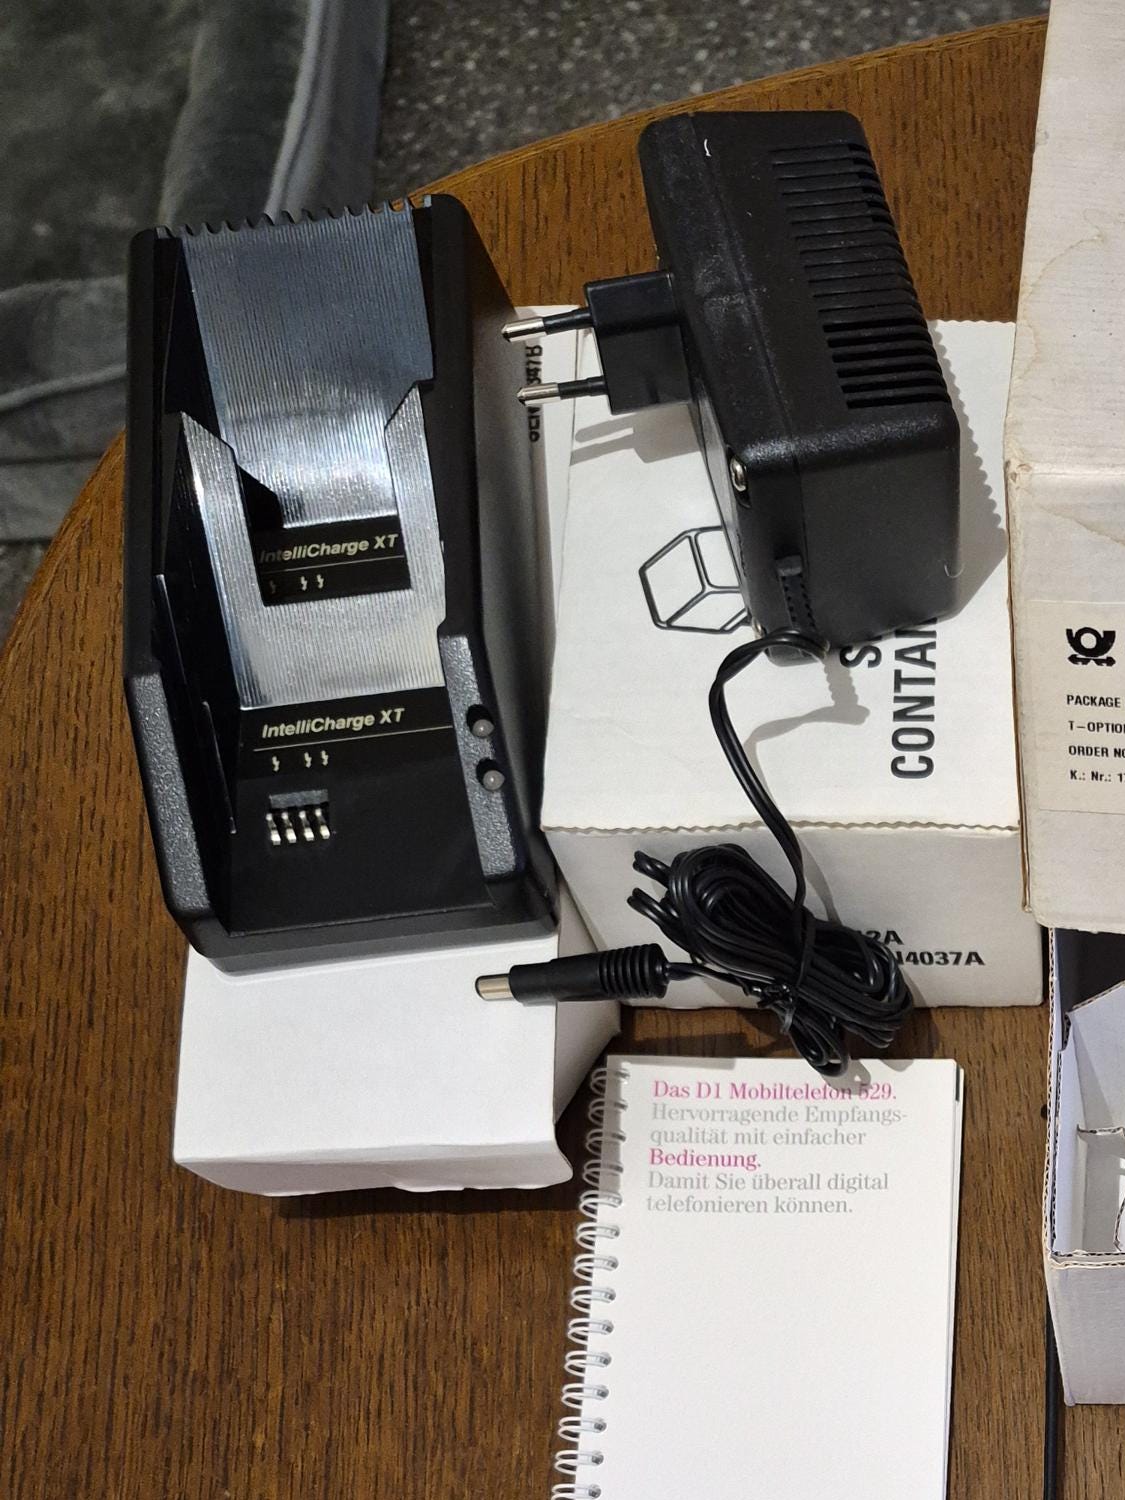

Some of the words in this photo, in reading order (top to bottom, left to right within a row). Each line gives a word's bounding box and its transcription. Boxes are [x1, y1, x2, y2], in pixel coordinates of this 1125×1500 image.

[259, 539, 369, 563] IntelliCharge
[374, 533, 398, 549] XT
[1067, 695, 1120, 708] PACKAGE
[262, 714, 375, 738] IntelliCharge
[380, 708, 405, 724] XT
[1069, 746, 1109, 757] ORDER
[652, 1080, 690, 1098] Das
[696, 1082, 721, 1099] D1
[730, 1082, 850, 1100] Mobiltelefon
[652, 1103, 799, 1124] Hervorragende
[805, 1106, 907, 1126] Empfangs-
[650, 1126, 728, 1147] qualität
[734, 1129, 766, 1145] mit
[772, 1128, 866, 1146] einfacher
[649, 1148, 761, 1171] Bedienung.
[648, 1171, 709, 1189] Damit
[715, 1174, 746, 1190] Sie
[752, 1174, 821, 1191] überall
[827, 1174, 889, 1193] digital
[647, 1195, 769, 1213] telefonieren
[775, 1197, 852, 1214] können.
